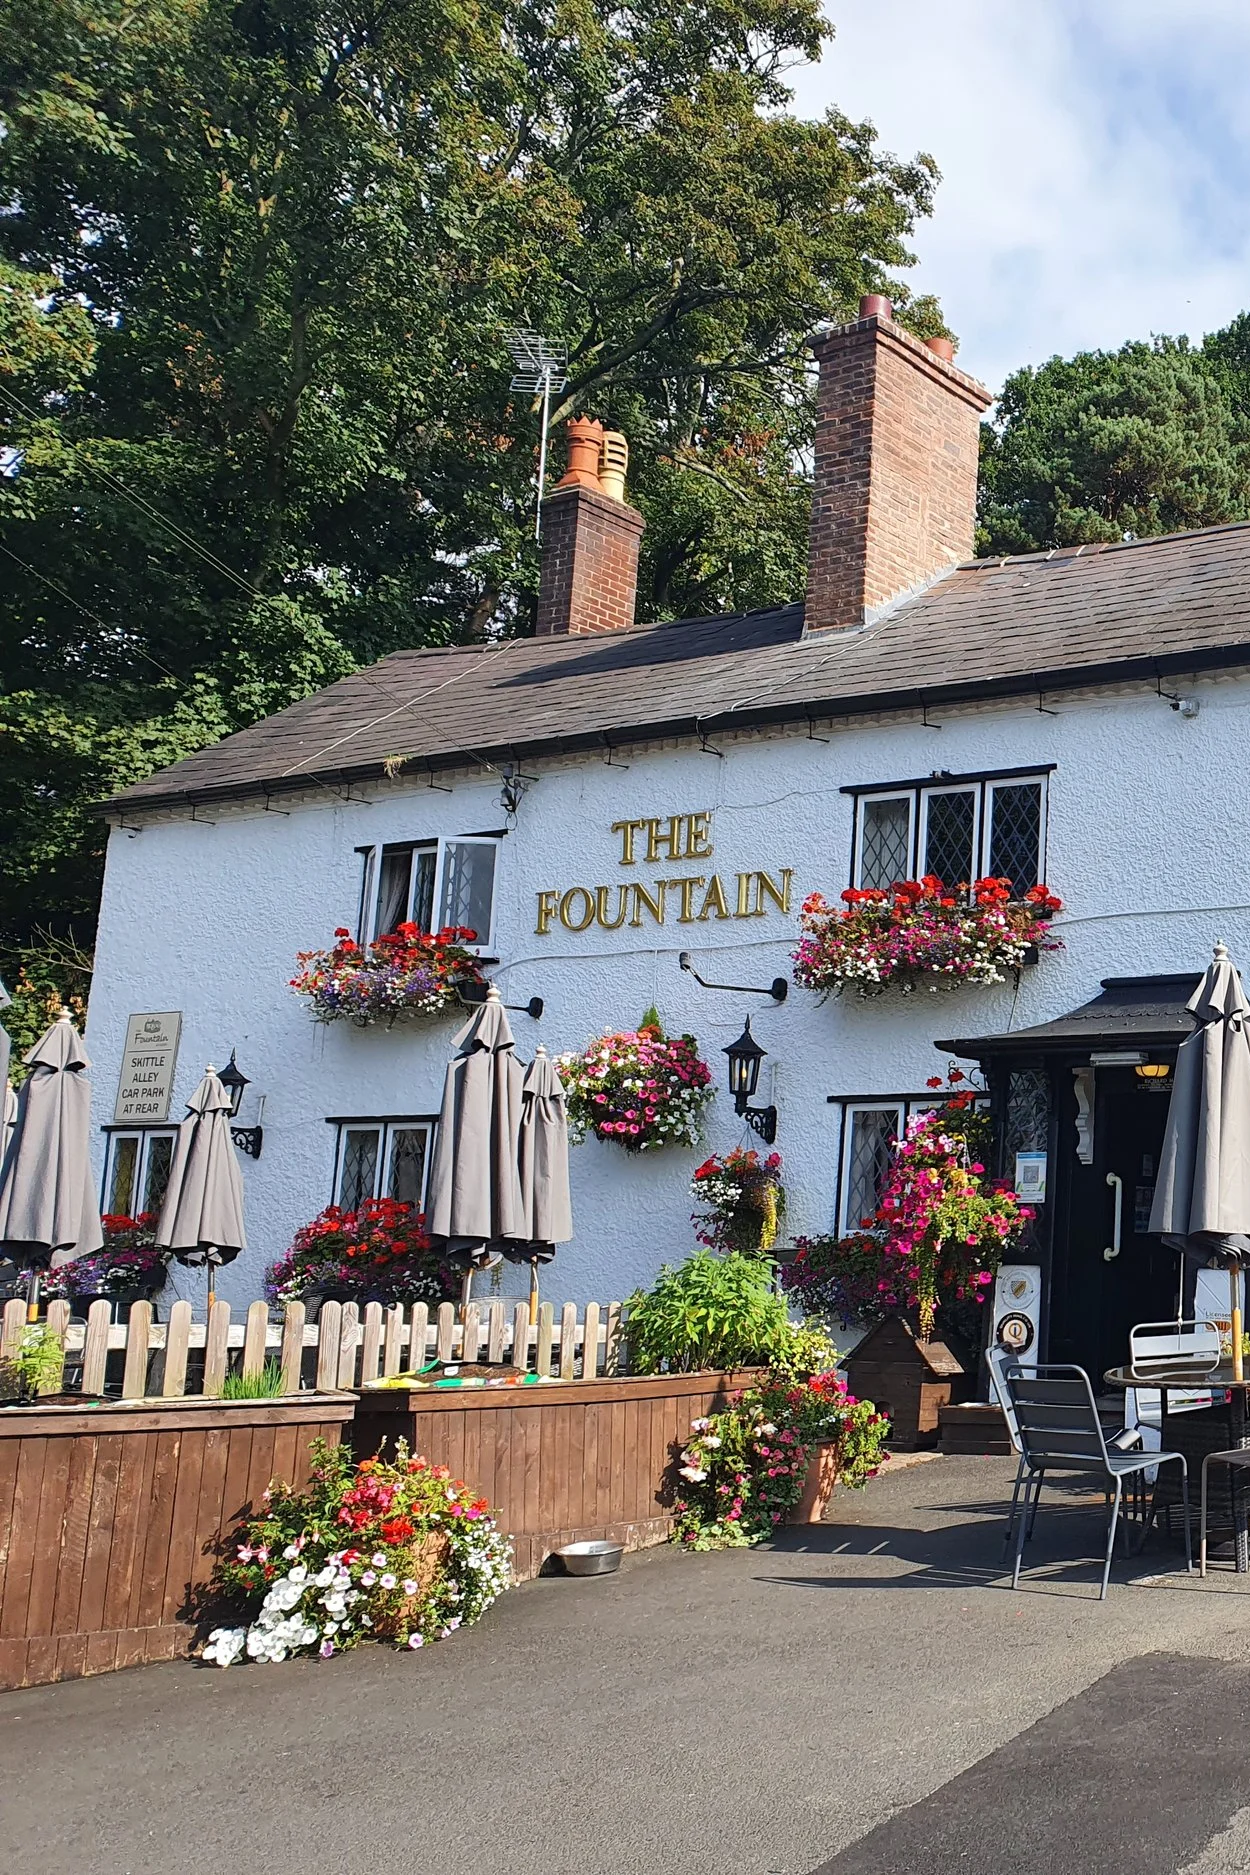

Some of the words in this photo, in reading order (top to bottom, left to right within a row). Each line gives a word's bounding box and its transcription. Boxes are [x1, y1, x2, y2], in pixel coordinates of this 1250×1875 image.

[610, 811, 714, 865] THE
[533, 867, 795, 935] FOUNTAIN
[134, 1033, 169, 1045] Fountain
[131, 1056, 165, 1068] SKITTLE
[132, 1072, 159, 1083] ALLEY
[122, 1088, 139, 1099] CAR
[141, 1087, 165, 1098] PARK
[123, 1103, 134, 1114] AT
[135, 1103, 159, 1113] REAR
